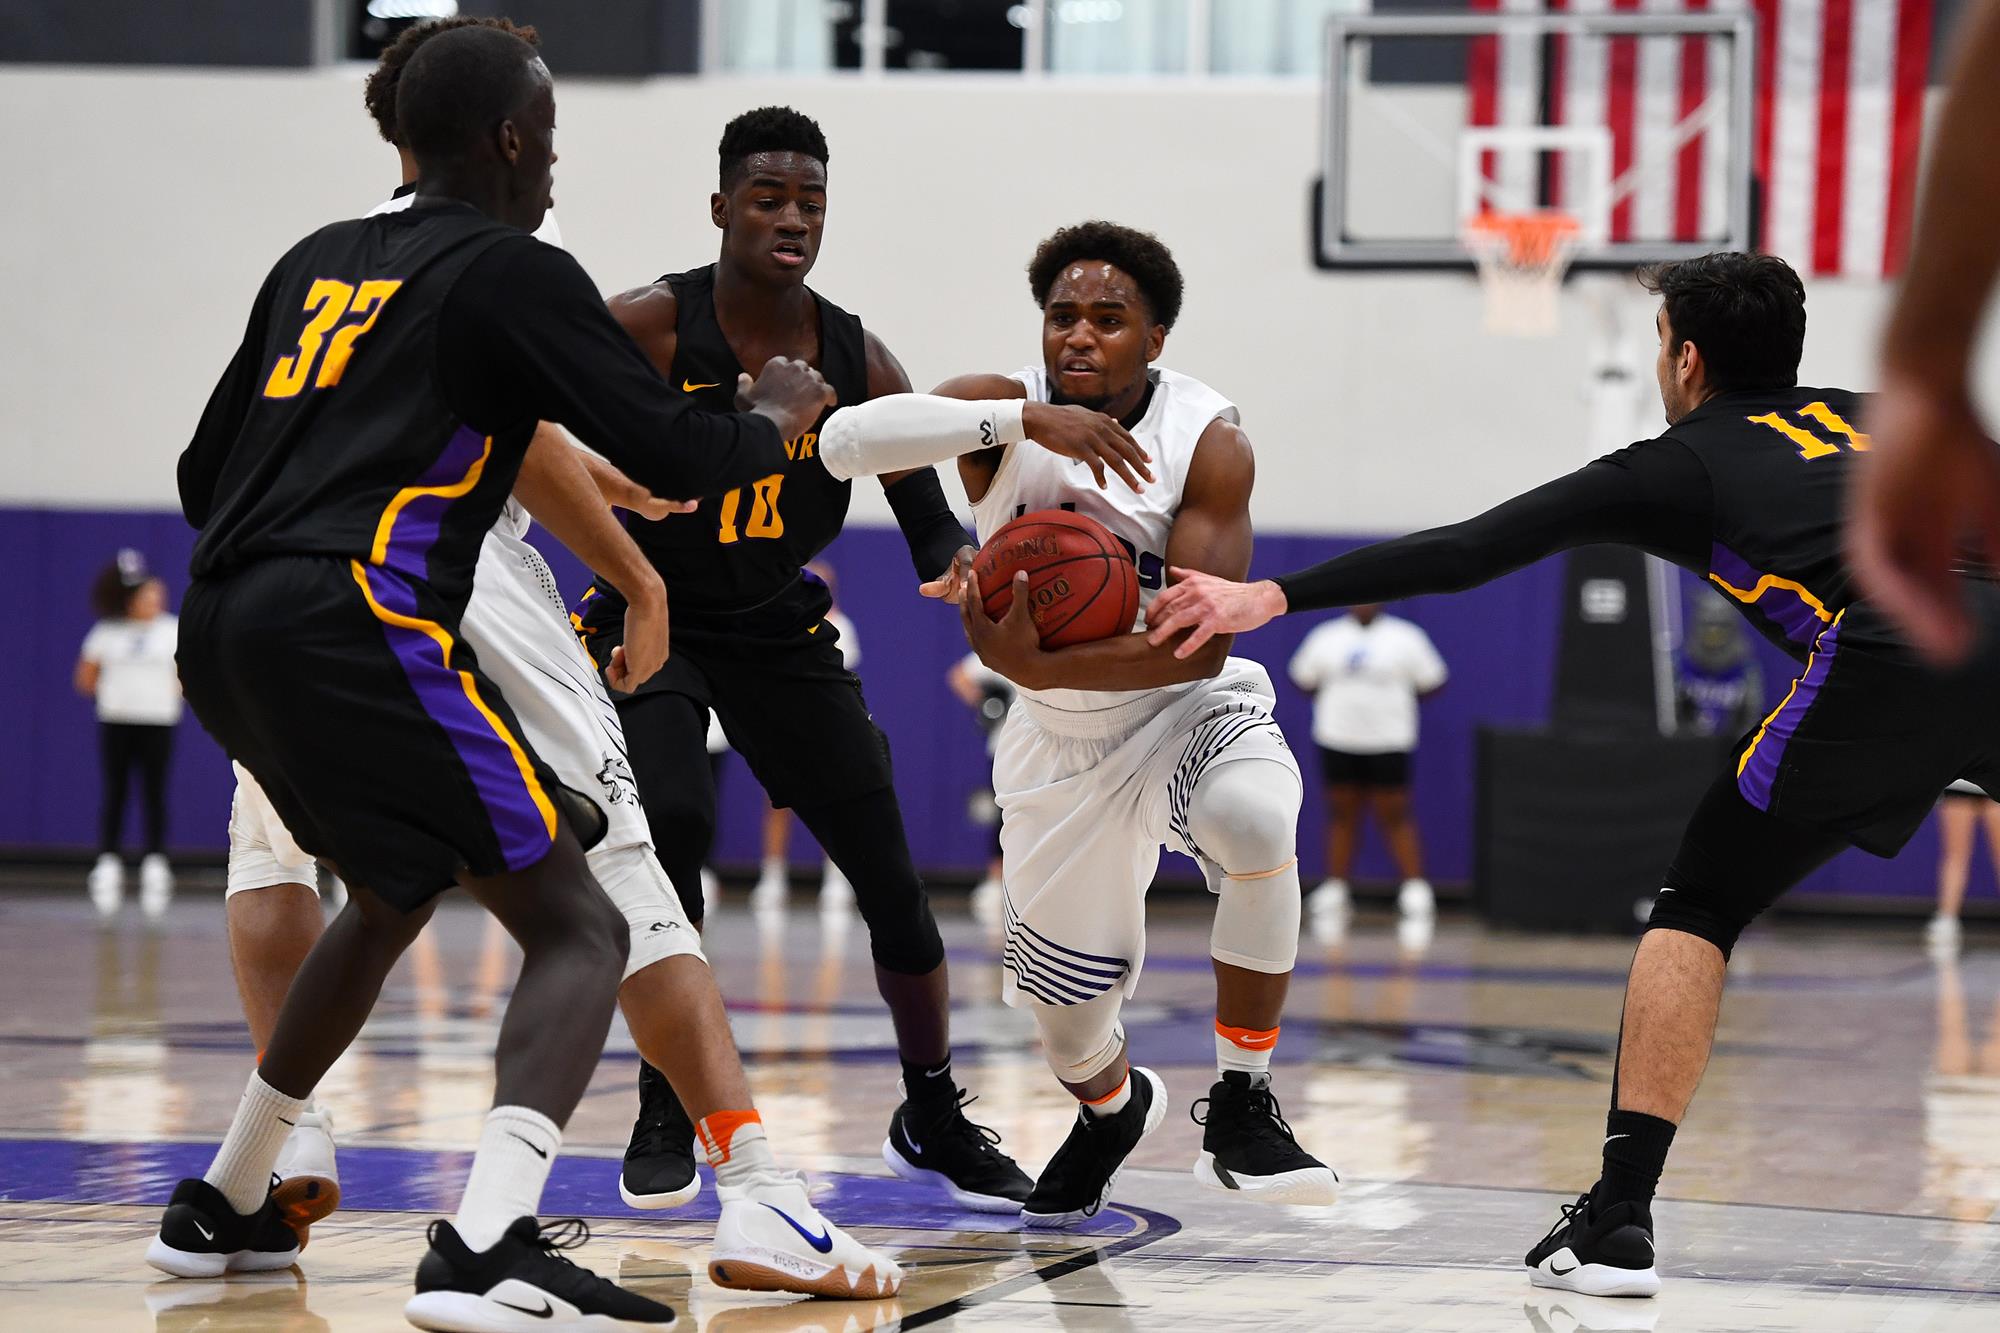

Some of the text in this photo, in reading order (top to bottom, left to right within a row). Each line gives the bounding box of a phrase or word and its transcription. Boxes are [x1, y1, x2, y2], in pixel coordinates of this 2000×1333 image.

[262, 278, 403, 398] 32
[1746, 401, 1873, 460] 11
[718, 473, 785, 544] 10
